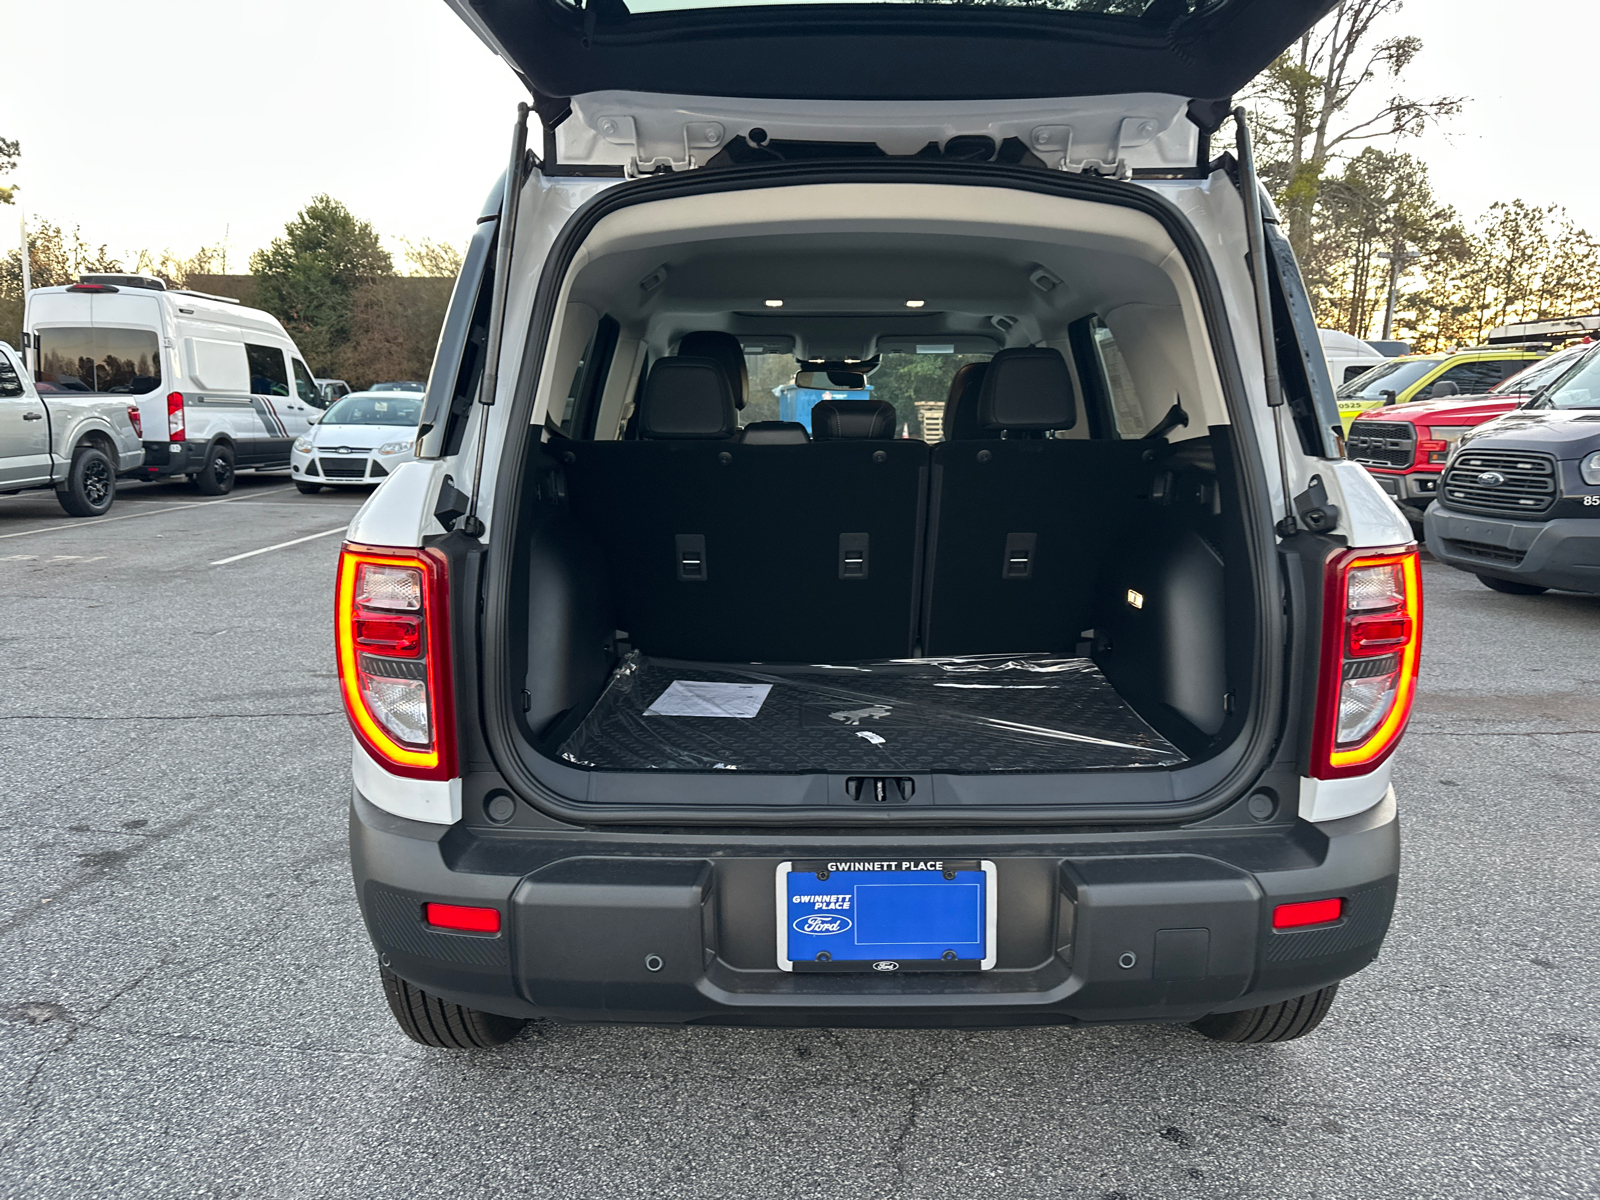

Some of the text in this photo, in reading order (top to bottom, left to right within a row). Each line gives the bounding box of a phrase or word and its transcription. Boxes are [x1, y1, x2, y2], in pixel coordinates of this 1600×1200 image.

[1583, 495, 1600, 506] 85
[827, 861, 944, 871] GWINNETT PLACE
[792, 894, 852, 903] GWINNETT
[814, 902, 851, 910] PLACE
[804, 916, 841, 932] Ford
